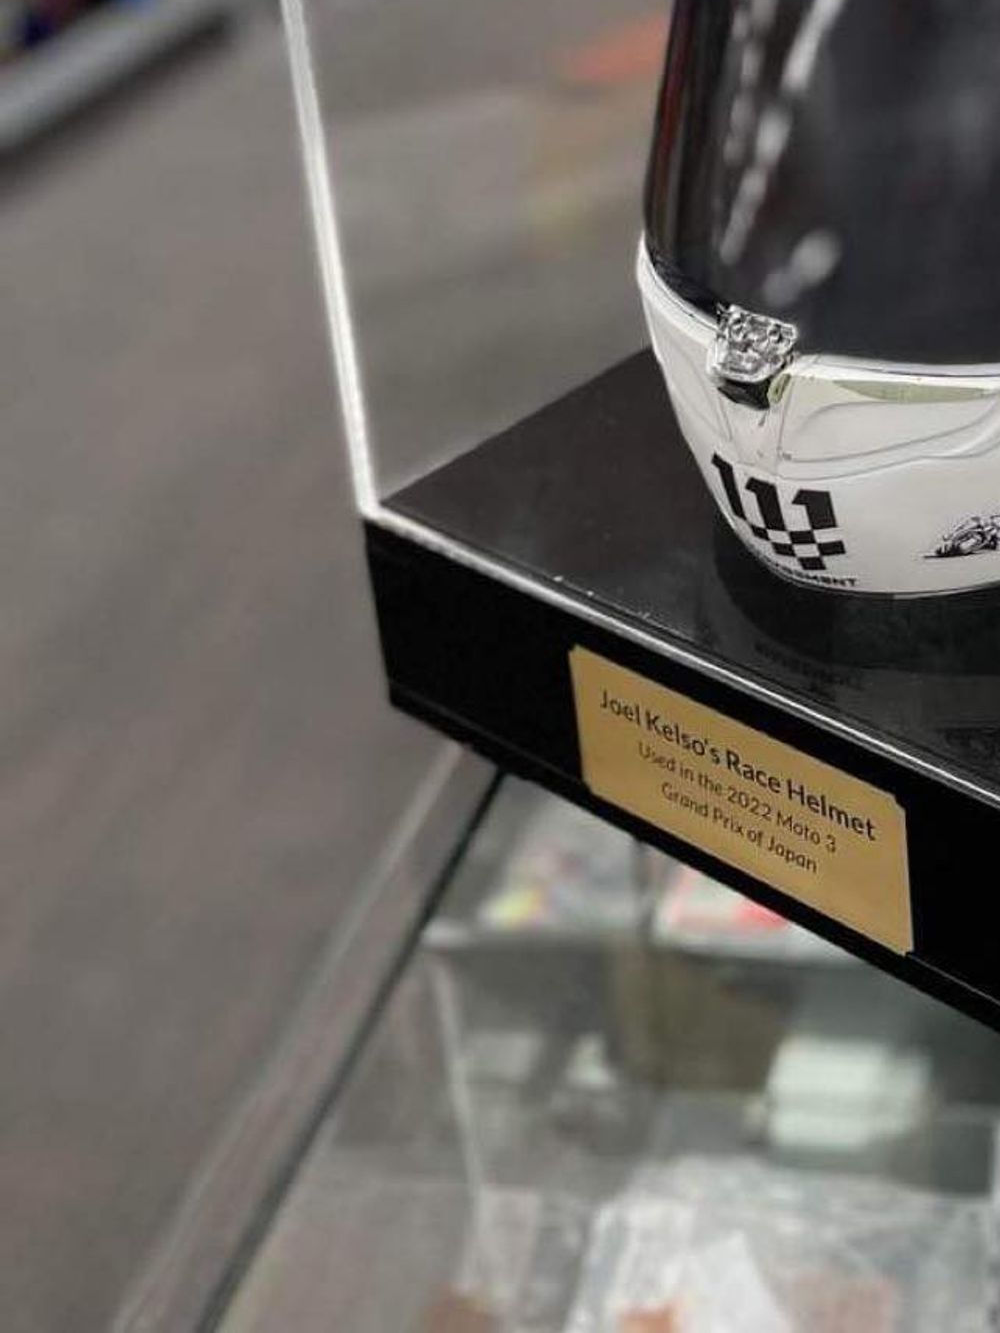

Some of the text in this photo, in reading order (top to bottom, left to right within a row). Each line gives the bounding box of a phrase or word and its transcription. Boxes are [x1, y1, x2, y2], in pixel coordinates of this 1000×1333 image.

[711, 452, 846, 569] 111
[600, 689, 876, 841] Joel Kelso's Race Helmet
[638, 740, 836, 853] Used in the 2022 Moto 3
[661, 781, 817, 874] Grand Prix of Japan
